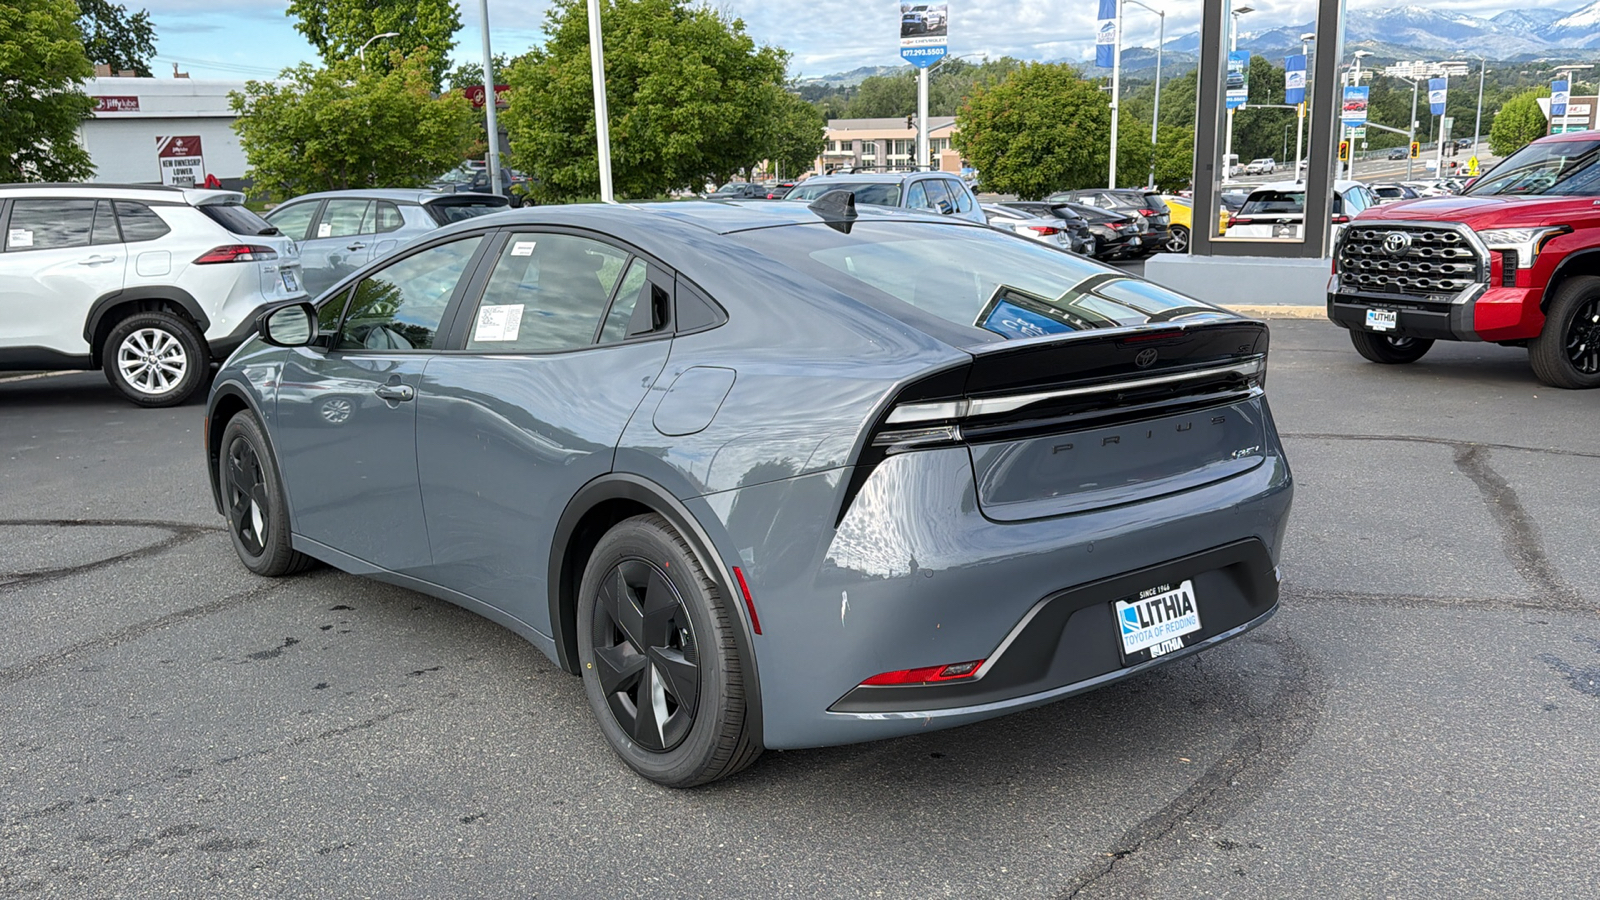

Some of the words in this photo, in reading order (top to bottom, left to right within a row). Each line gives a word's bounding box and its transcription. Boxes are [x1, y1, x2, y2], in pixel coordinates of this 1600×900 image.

[173, 167, 193, 175] LOWER
[174, 158, 201, 167] OWNERSHIP
[1374, 312, 1395, 322] LITHIA
[1052, 416, 1226, 454] PRIUS
[1140, 587, 1156, 598] SINCE
[1157, 583, 1170, 593] 1946
[1136, 591, 1194, 629] LITHIA
[1124, 630, 1153, 646] TOYOTA
[1154, 626, 1164, 637] OF
[1166, 615, 1196, 633] REDDING
[1158, 636, 1184, 655] LITHIA
